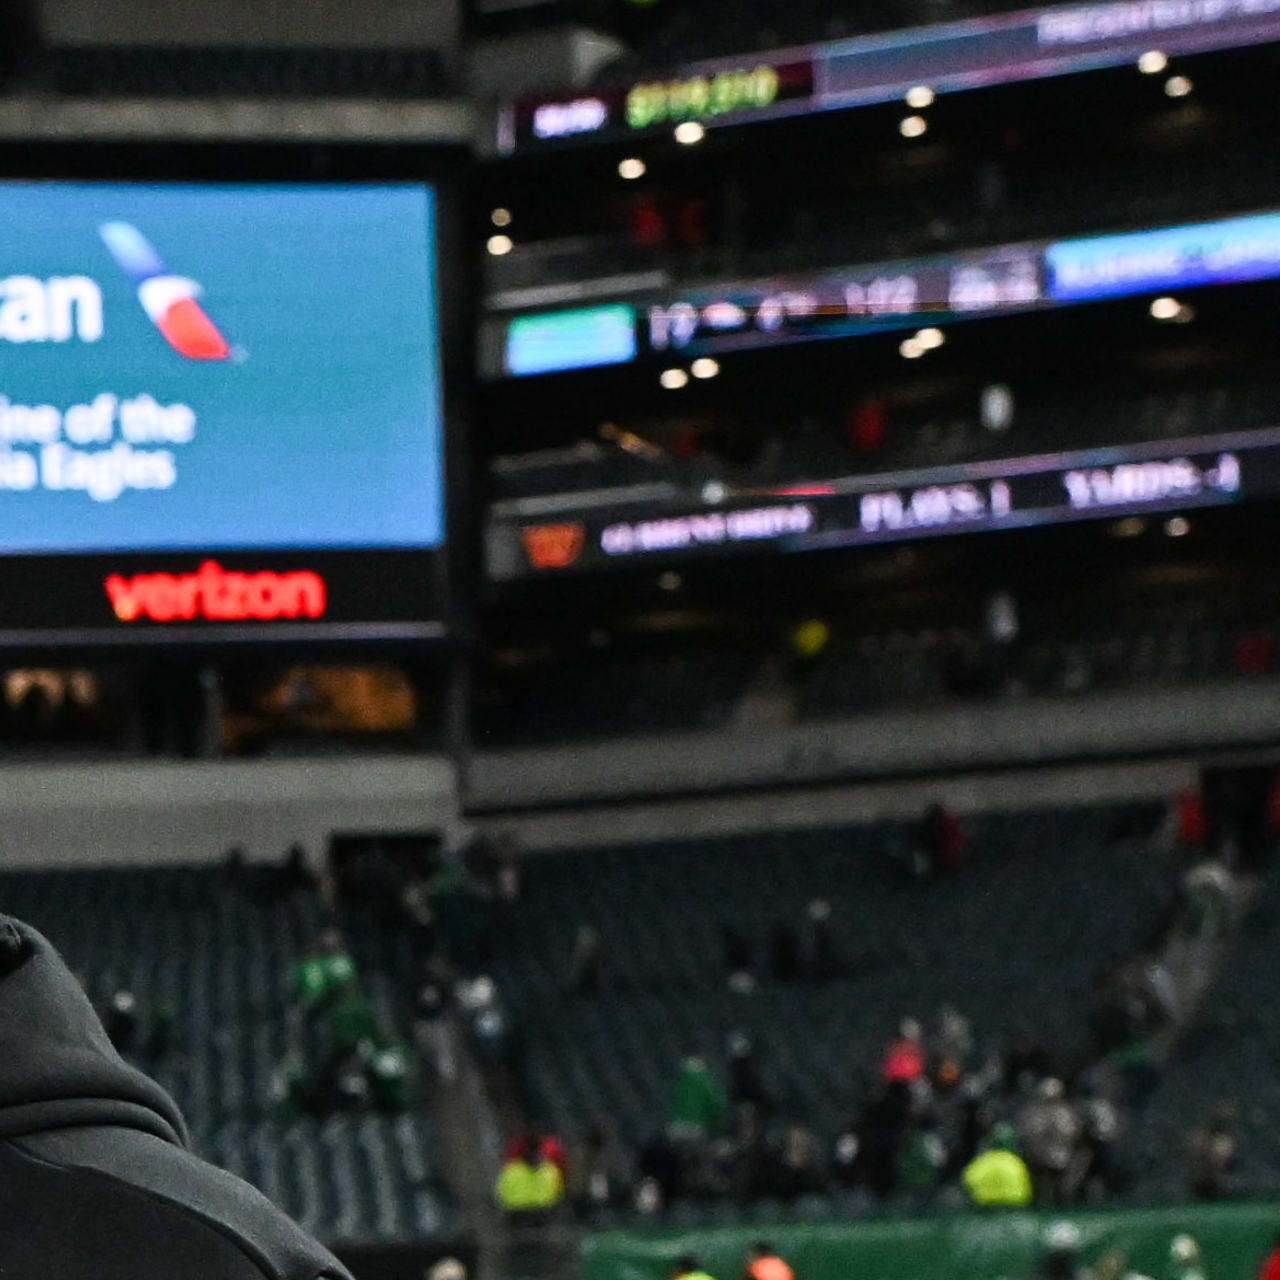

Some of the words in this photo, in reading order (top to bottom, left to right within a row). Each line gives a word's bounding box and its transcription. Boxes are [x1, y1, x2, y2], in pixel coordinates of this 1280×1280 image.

[64, 391, 118, 444] of
[119, 391, 197, 443] the
[41, 442, 178, 501] Eagles
[104, 560, 326, 621] verizon
